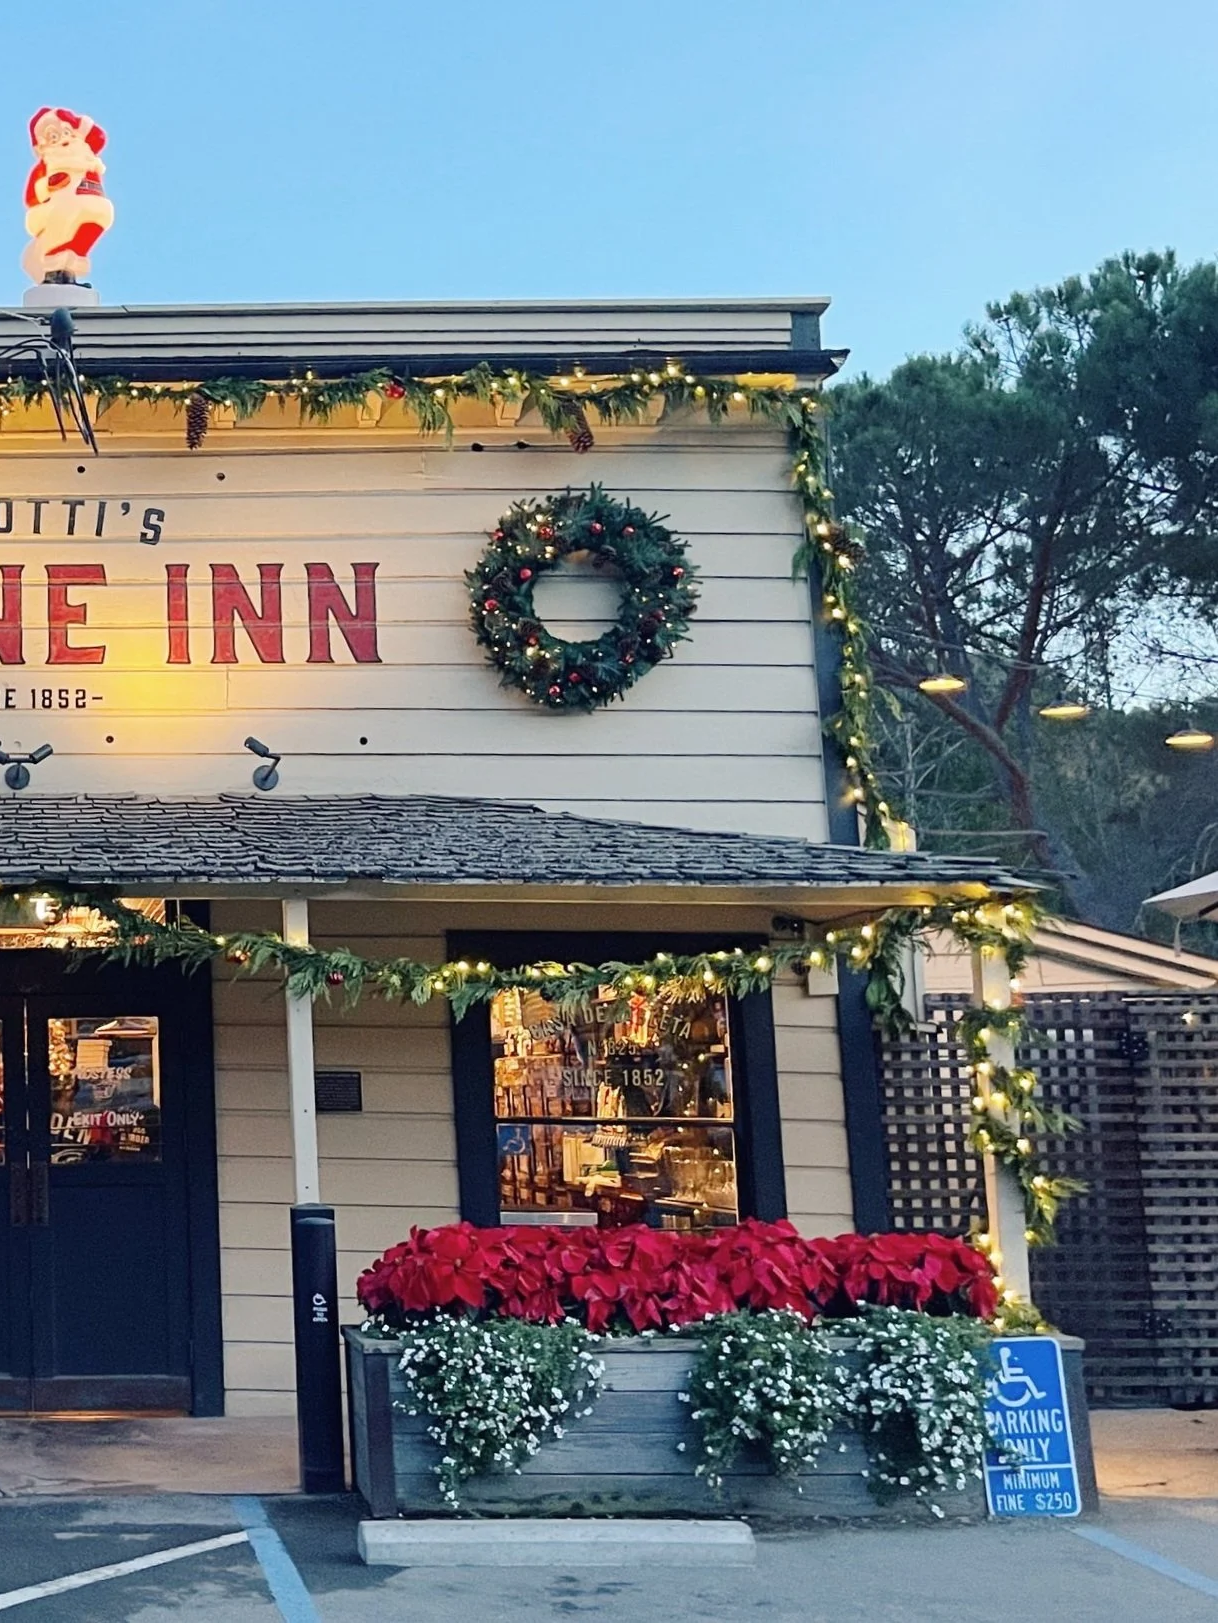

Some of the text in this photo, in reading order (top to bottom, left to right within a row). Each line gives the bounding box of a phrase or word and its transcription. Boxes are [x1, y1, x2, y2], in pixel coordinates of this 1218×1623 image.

[165, 562, 383, 664] INN
[583, 1006, 607, 1024] DE
[563, 1068, 665, 1087] SINCE 1852
[73, 1111, 140, 1127] EXIT ONLY
[1003, 1472, 1060, 1490] MINIMUM
[996, 1492, 1072, 1512] FINE $250
